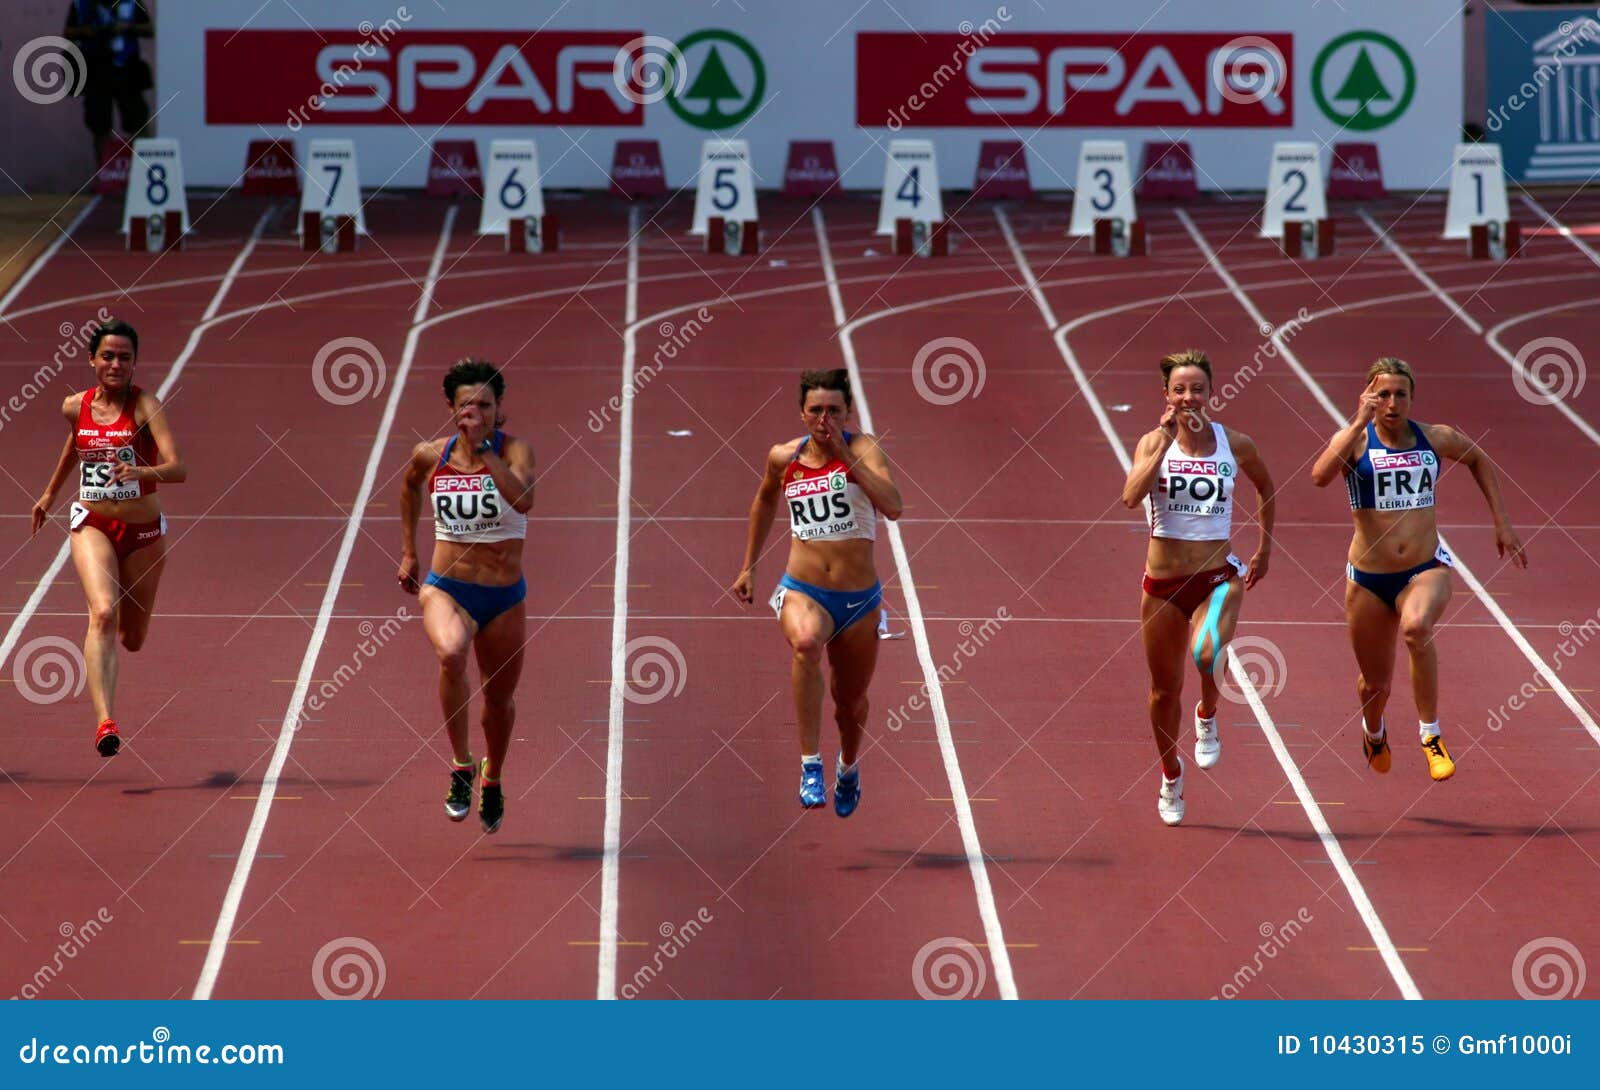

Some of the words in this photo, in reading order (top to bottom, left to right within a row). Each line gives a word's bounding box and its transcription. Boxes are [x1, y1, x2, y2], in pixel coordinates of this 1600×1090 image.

[316, 44, 635, 113] SPAR
[966, 46, 1285, 116] SPAR
[146, 164, 169, 206] 8
[322, 165, 342, 207] 7
[499, 167, 526, 210] 6
[712, 167, 740, 211] 5
[895, 166, 921, 208] 4
[1091, 168, 1116, 212] 3
[1282, 170, 1308, 213] 2
[1471, 172, 1485, 216] 1
[82, 462, 123, 487] ES
[1169, 461, 1217, 474] SPAR
[1374, 454, 1420, 468] SPAR
[112, 490, 137, 499] 2009
[436, 479, 481, 490] SPAR
[787, 479, 829, 497] SPAR
[1169, 476, 1227, 502] POL
[1378, 468, 1433, 496] FRA
[71, 507, 83, 523] 7
[437, 494, 498, 520] RUS
[791, 493, 850, 526] RUS
[1168, 504, 1201, 513] LEIRIA
[1380, 500, 1412, 509] LEIRIA
[796, 527, 825, 538] EIRIA
[829, 521, 853, 533] 2009
